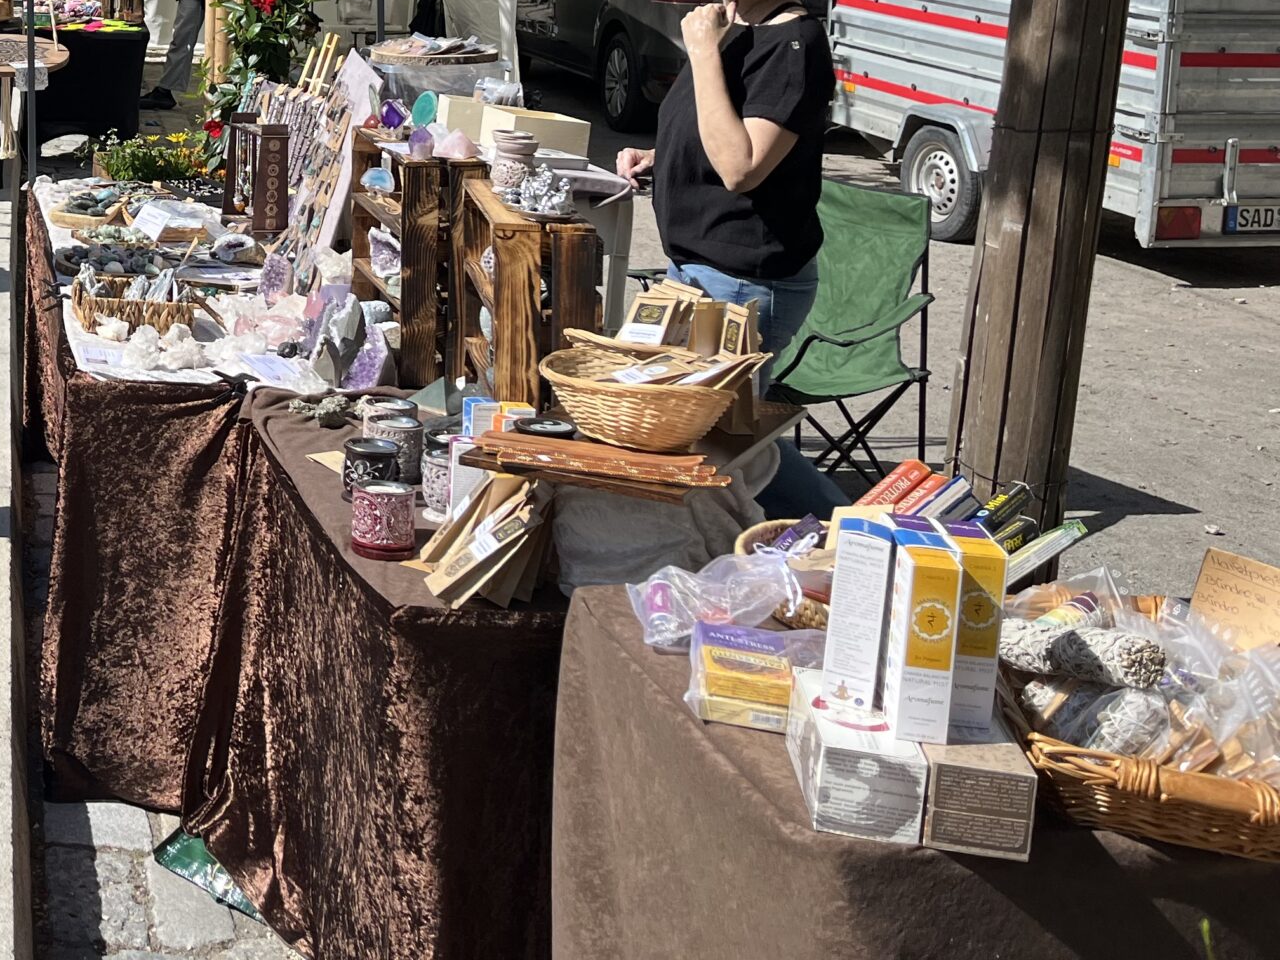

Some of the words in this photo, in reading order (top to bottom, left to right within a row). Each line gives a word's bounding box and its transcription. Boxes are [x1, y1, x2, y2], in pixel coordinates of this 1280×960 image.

[1238, 208, 1274, 227] SAD
[987, 493, 1009, 511] Mist
[708, 631, 775, 651] ANTI-STRESS
